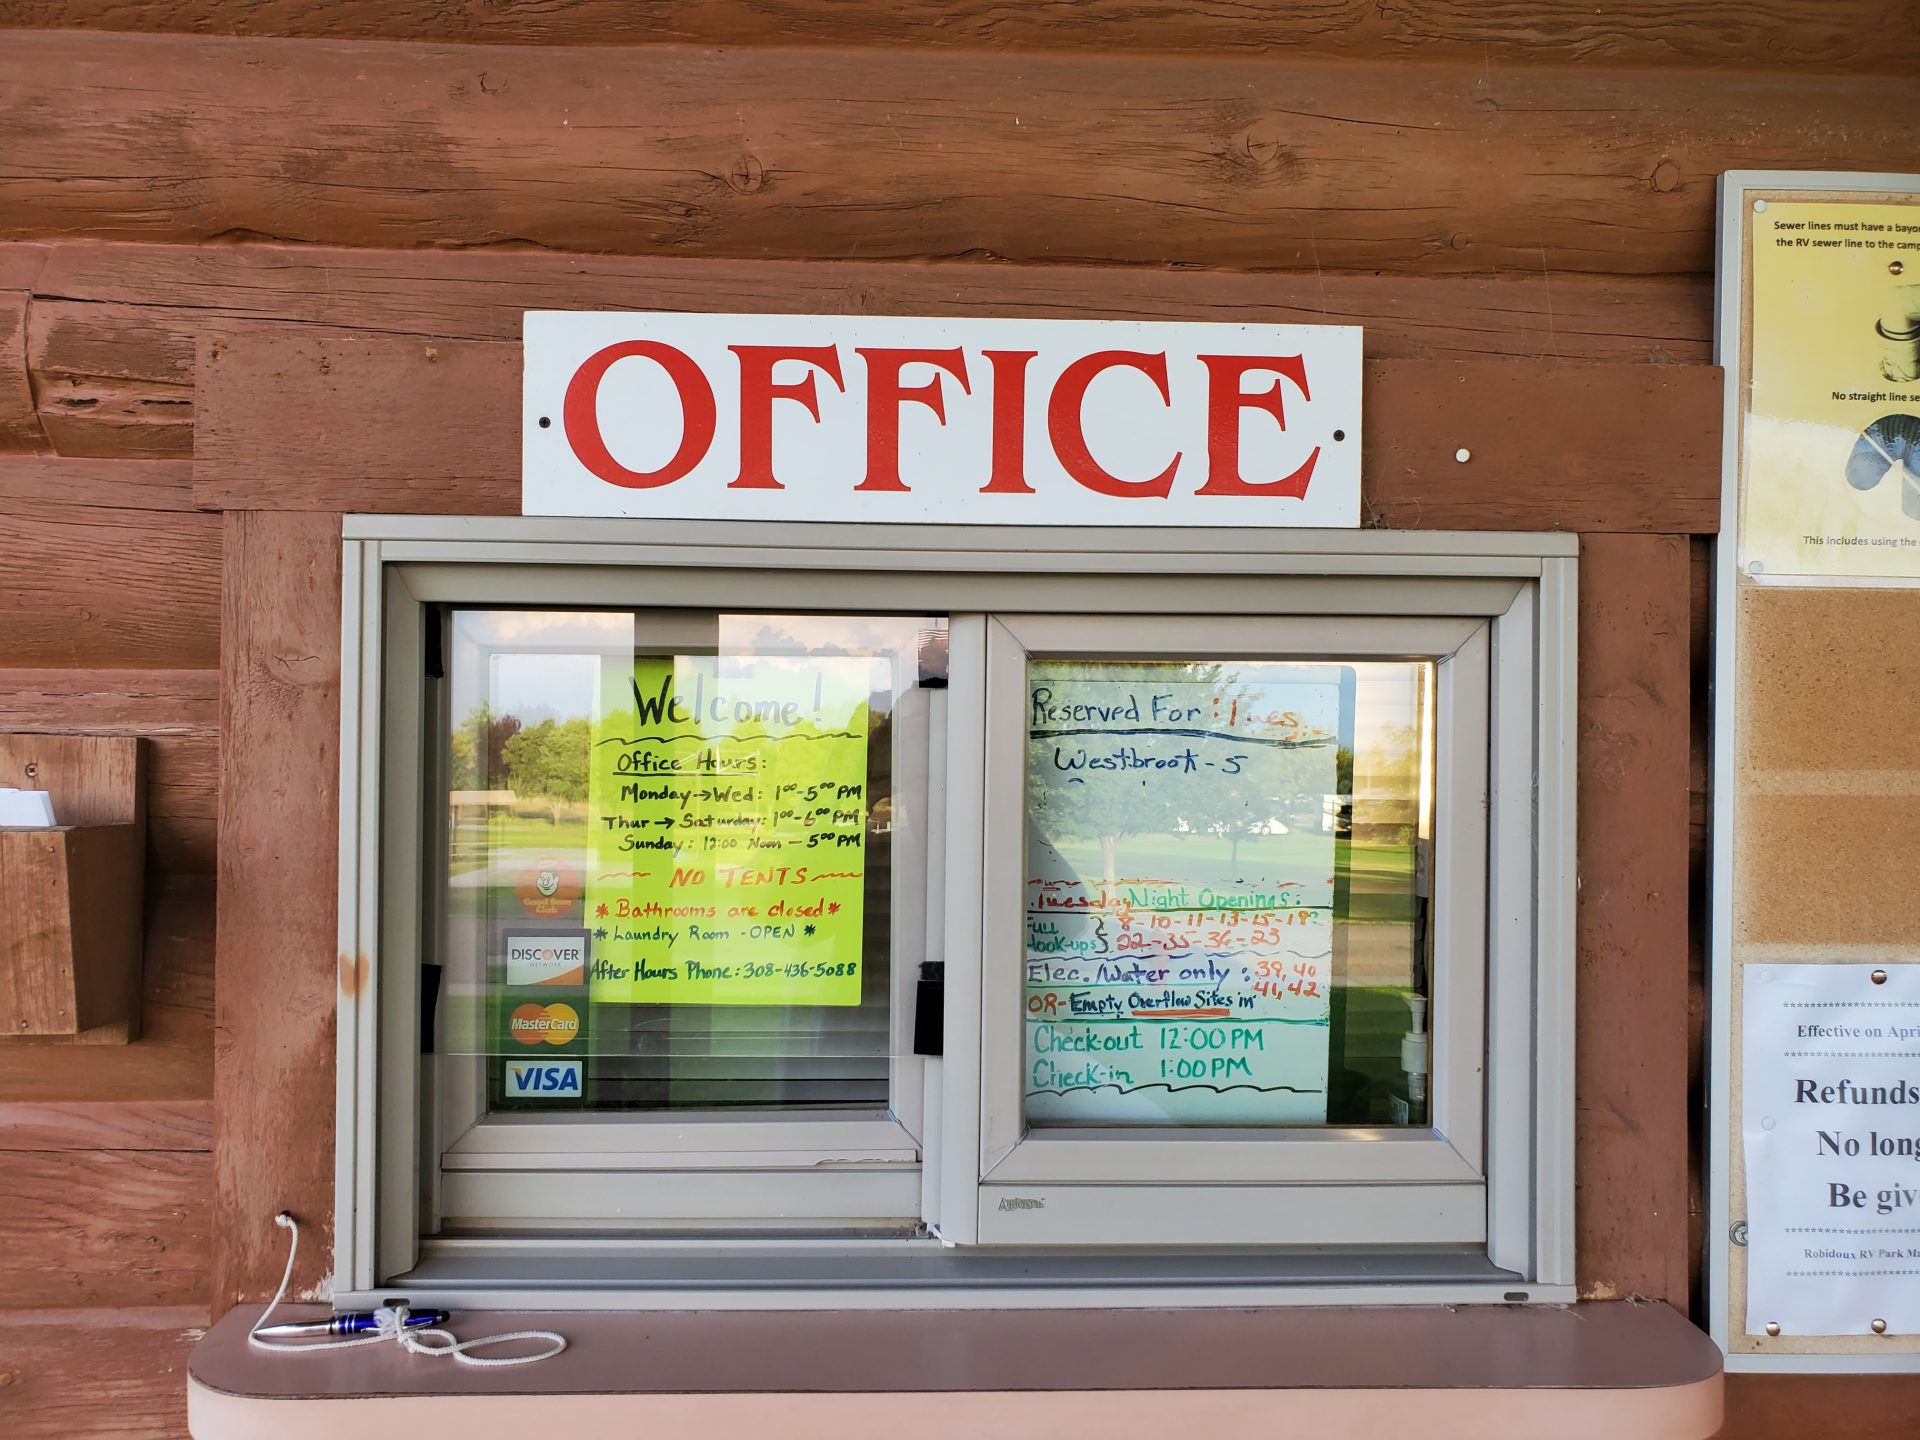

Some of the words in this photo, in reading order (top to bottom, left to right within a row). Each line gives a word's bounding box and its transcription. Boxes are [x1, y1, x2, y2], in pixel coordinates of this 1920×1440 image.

[1774, 220, 1806, 230] Sewer
[1808, 220, 1832, 231] lines
[1833, 222, 1859, 231] must
[1861, 222, 1885, 232] have
[1895, 223, 1920, 234] bayo
[1776, 238, 1793, 247] the
[1796, 238, 1810, 247] RV
[1812, 240, 1843, 248] sewer
[1844, 239, 1863, 248] line
[1865, 240, 1876, 248] to
[1878, 240, 1895, 249] the
[1832, 391, 1846, 400] No
[1848, 391, 1887, 403] straight
[1889, 392, 1908, 402] line
[563, 339, 1322, 502] OFFICE
[1803, 536, 1824, 545] This
[1826, 536, 1869, 546] includes
[1871, 537, 1898, 548] using
[1900, 538, 1917, 547] the
[628, 671, 823, 727] Welcome!
[1032, 688, 1140, 726] Reserved
[1151, 694, 1201, 722] For
[617, 748, 683, 772] Office
[620, 782, 692, 810] Monday
[836, 784, 863, 800] PM
[601, 815, 650, 830] Thur
[832, 808, 860, 827] PM
[702, 834, 739, 851] 12:00
[836, 832, 862, 848] PM
[668, 867, 706, 889] NO
[719, 867, 810, 887] TENTS
[615, 898, 717, 919] Bathrooms
[727, 904, 760, 918] are
[1128, 887, 1190, 910] Night
[613, 925, 679, 949] Laundry
[689, 924, 730, 941] Room
[511, 948, 581, 961] DISCOVER
[588, 960, 631, 982] After
[633, 958, 678, 982] Hours
[1293, 962, 1317, 978] 40
[1287, 979, 1321, 999] 42
[1068, 991, 1124, 1019] Empty
[1127, 990, 1192, 1009] Overflow
[1193, 990, 1234, 1009] Sites
[511, 1018, 578, 1030] MasterCard
[1797, 1024, 1860, 1038] Effective
[1864, 1028, 1882, 1038] on
[511, 1066, 579, 1091] VISA
[1794, 1078, 1920, 1105] Refunds
[1816, 1130, 1860, 1157] No
[1827, 1182, 1867, 1208] Be
[1876, 1182, 1920, 1215] giv
[1804, 1248, 1856, 1259] Robidoux
[1859, 1249, 1877, 1259] RV
[1879, 1248, 1904, 1258] Park
